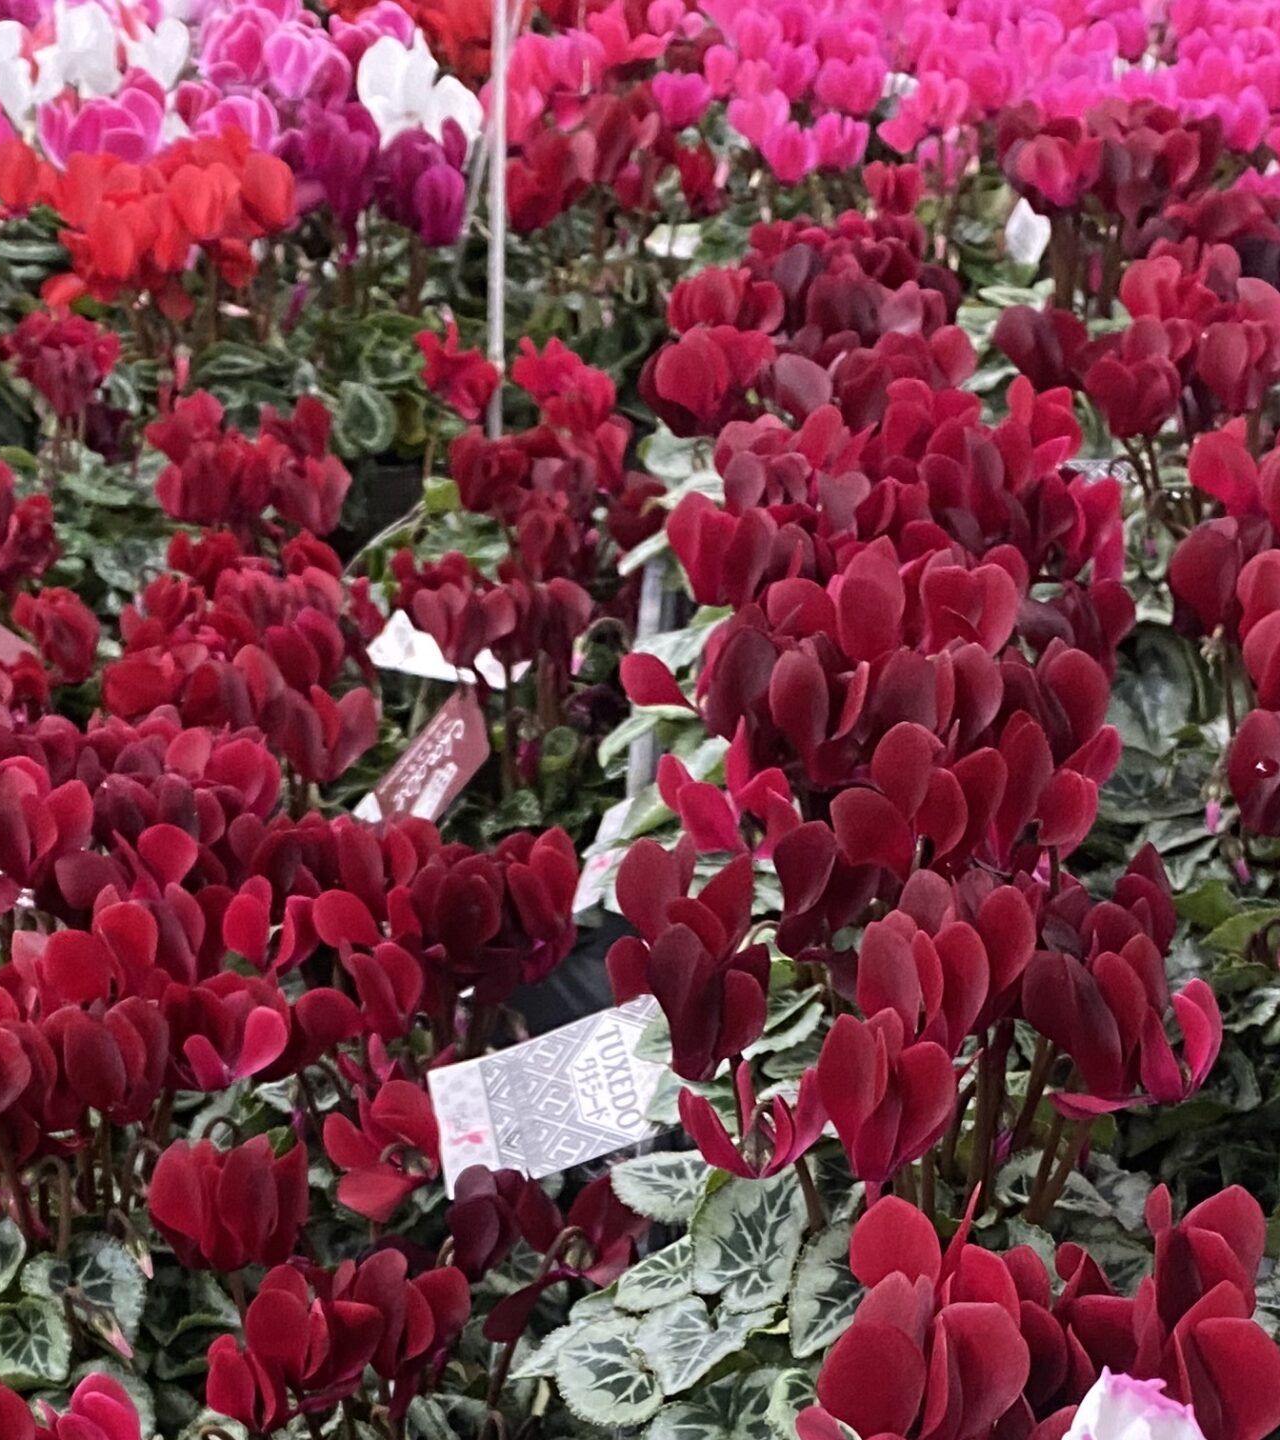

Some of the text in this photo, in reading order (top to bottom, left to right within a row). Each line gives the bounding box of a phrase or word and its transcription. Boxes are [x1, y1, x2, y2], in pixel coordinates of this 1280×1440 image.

[576, 1057, 612, 1121] タキシード
[595, 1023, 642, 1130] TUXEDO
